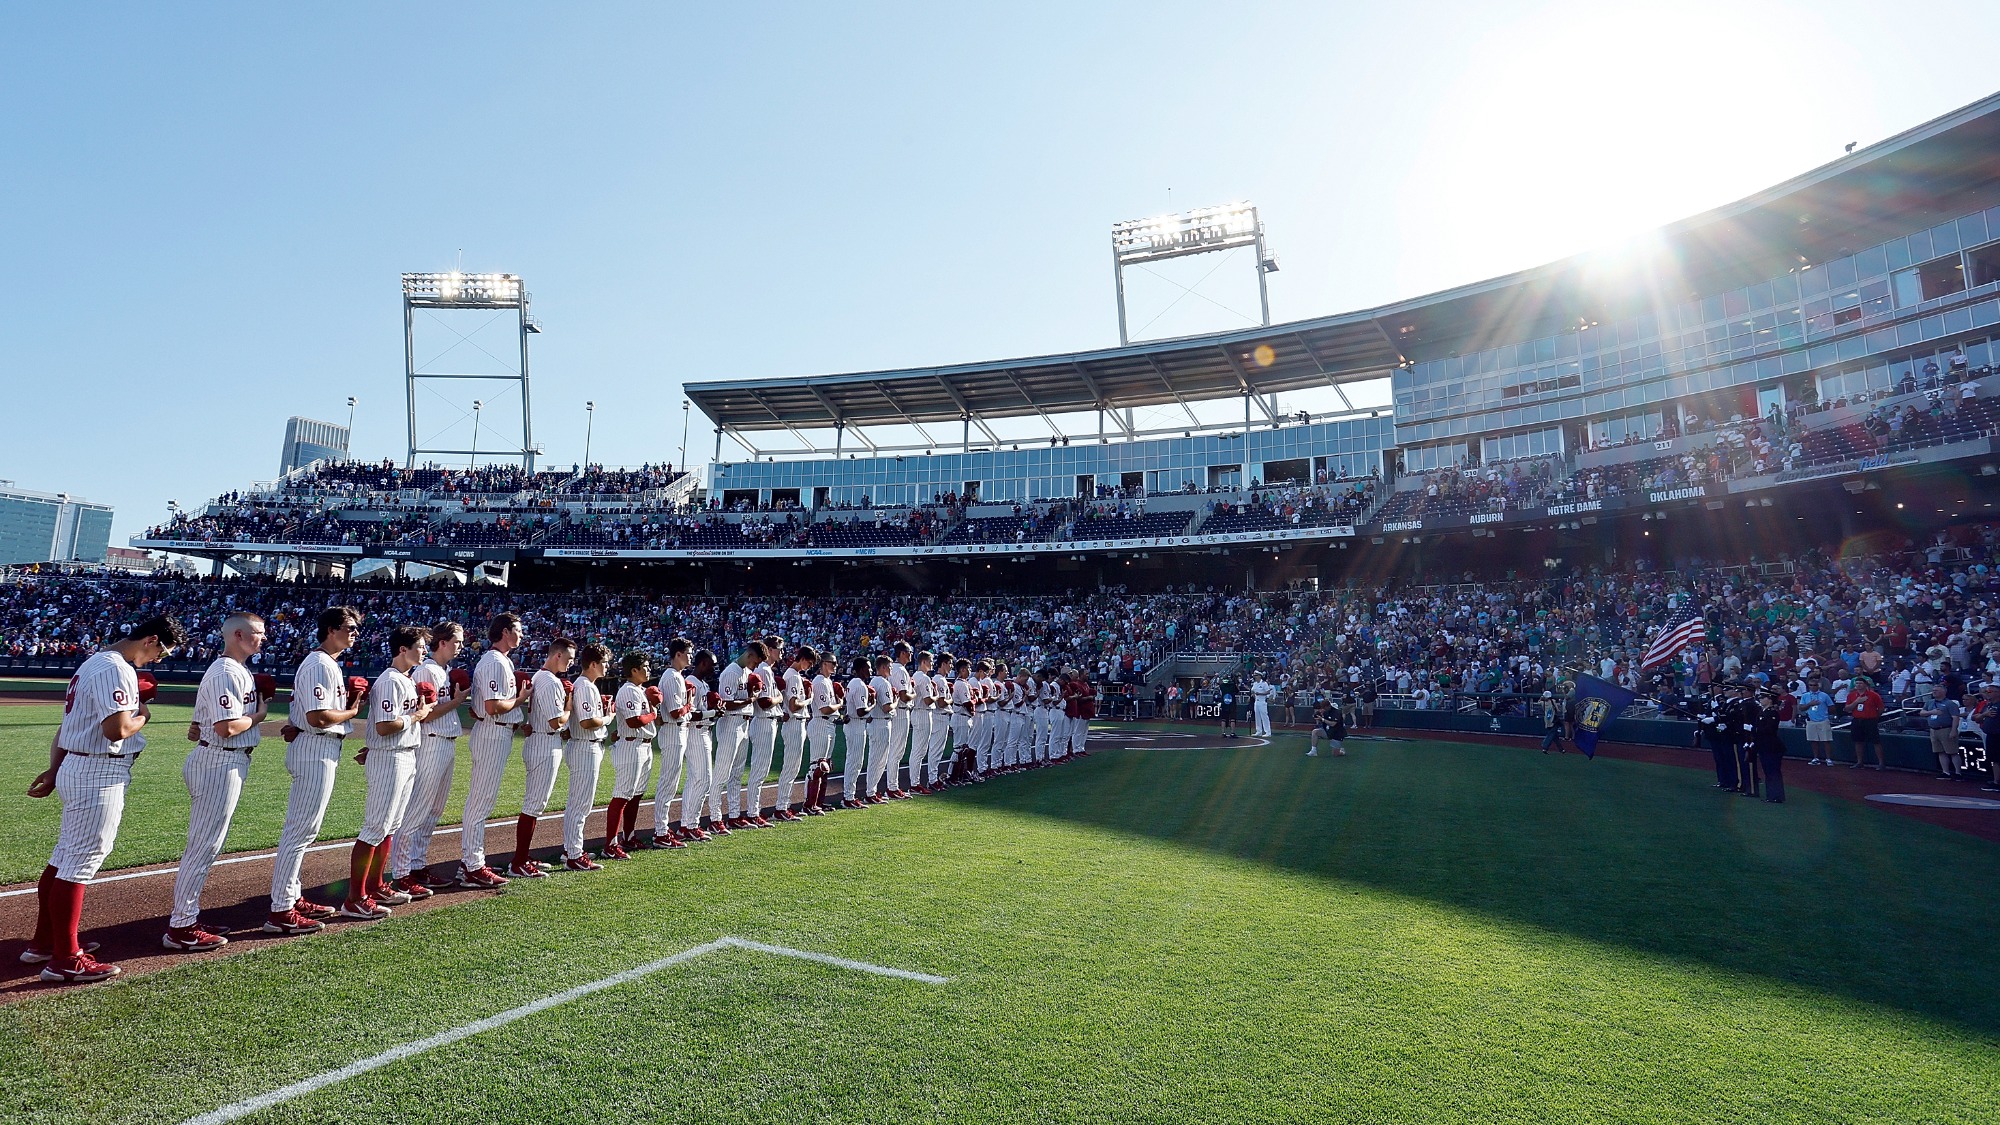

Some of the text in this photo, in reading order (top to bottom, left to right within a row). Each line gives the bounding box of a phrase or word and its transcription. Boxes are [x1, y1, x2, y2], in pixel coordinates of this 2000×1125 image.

[1859, 453, 1888, 472] field
[1650, 487, 1705, 503] OKLAHOMA
[1547, 501, 1602, 515] NOTRE DAME
[1470, 513, 1503, 524] AUBURN
[1383, 521, 1422, 532] ARKANSAS
[381, 699, 394, 713] OU
[1197, 705, 1220, 717] 0:20
